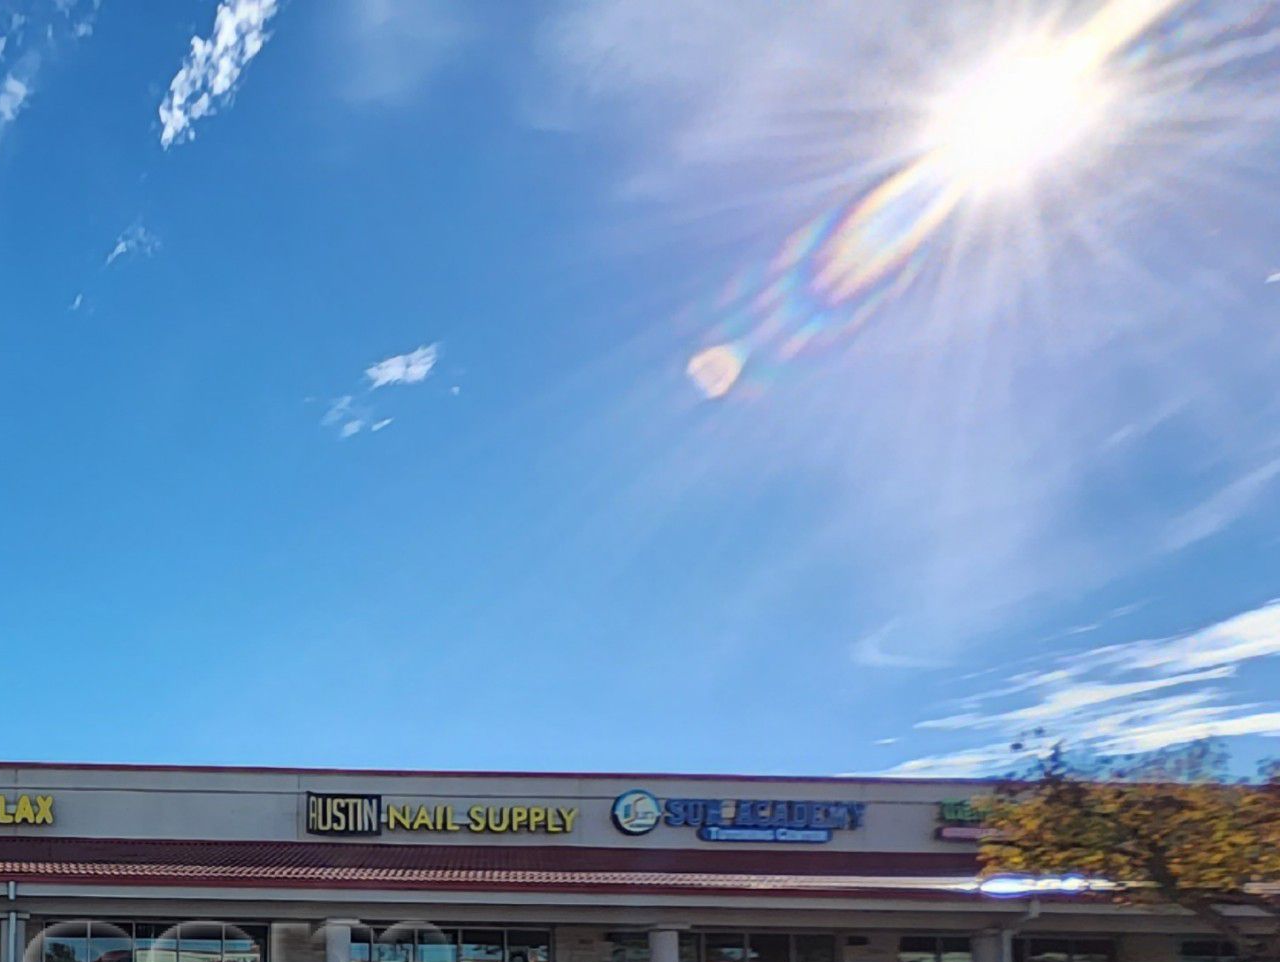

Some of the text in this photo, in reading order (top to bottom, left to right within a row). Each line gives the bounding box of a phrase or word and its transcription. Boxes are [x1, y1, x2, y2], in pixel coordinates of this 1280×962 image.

[308, 795, 580, 834] AUSTIN NAIL SUPPLY
